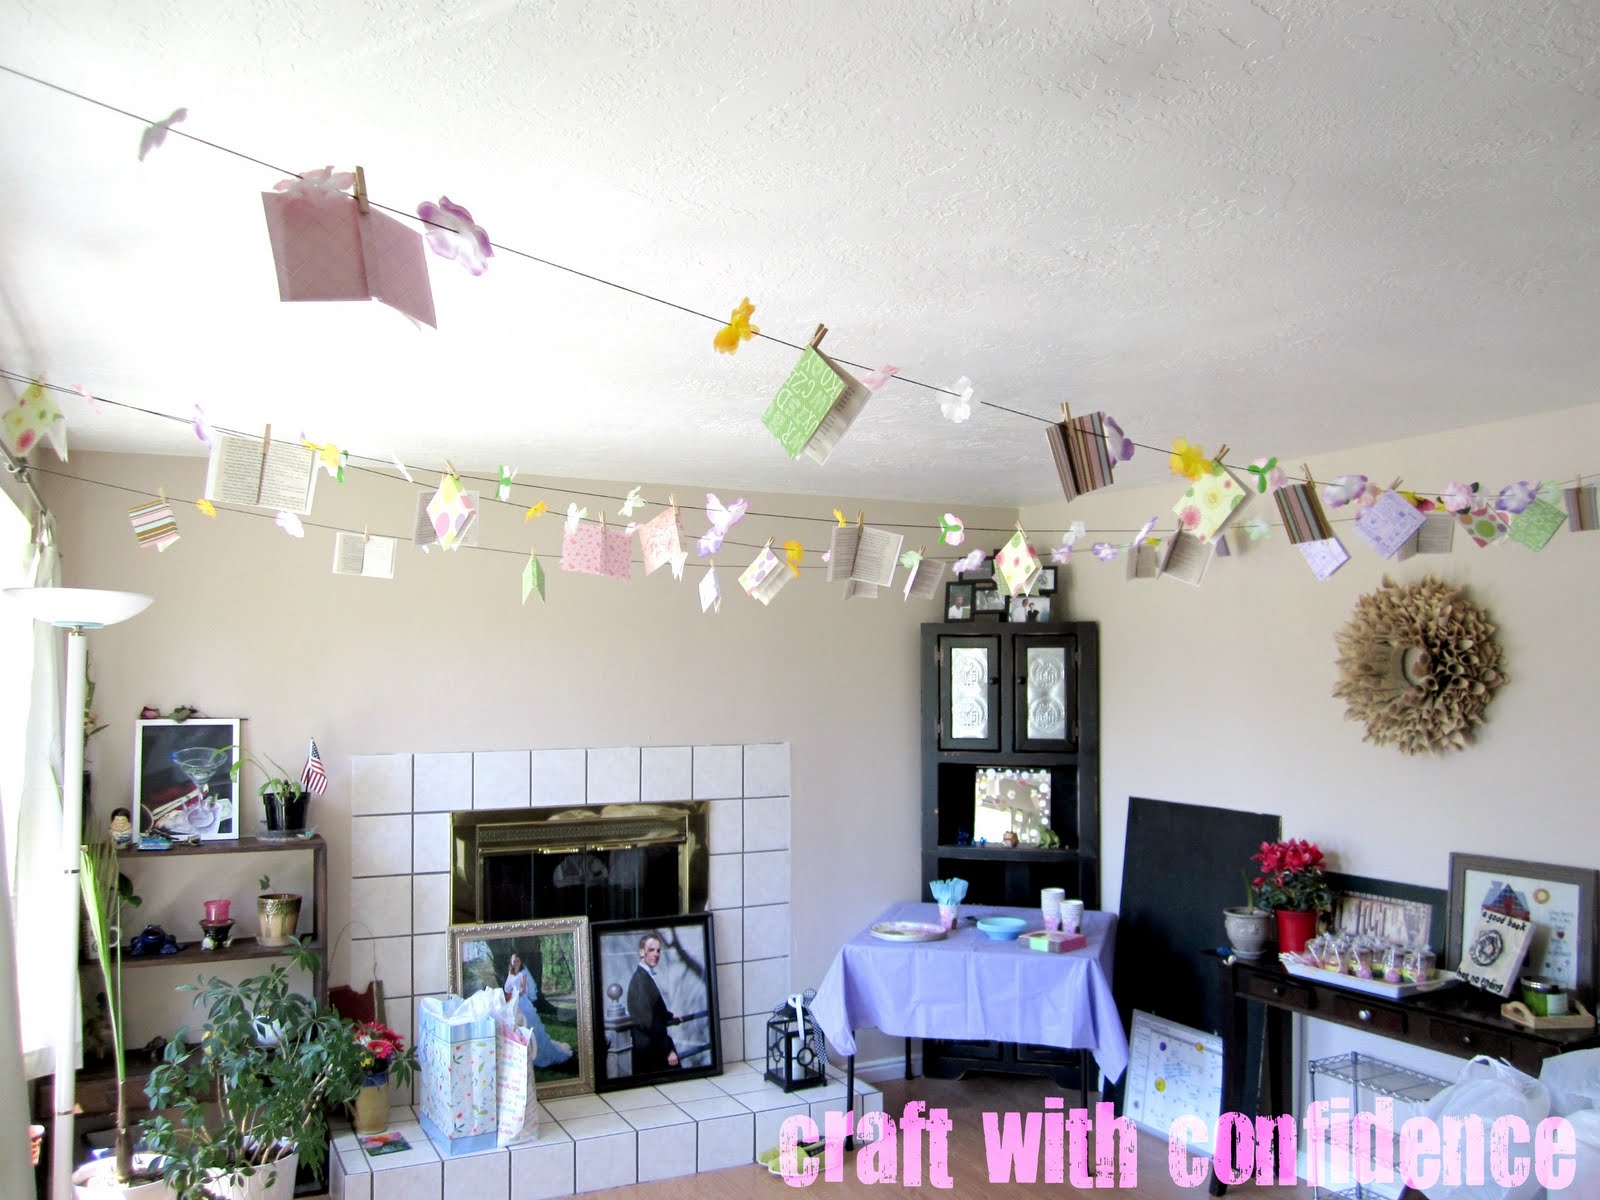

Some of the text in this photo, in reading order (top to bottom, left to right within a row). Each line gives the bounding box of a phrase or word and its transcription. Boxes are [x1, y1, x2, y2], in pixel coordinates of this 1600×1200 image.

[1486, 913, 1506, 924] good
[1507, 918, 1527, 931] book
[1457, 968, 1504, 993] has no ending
